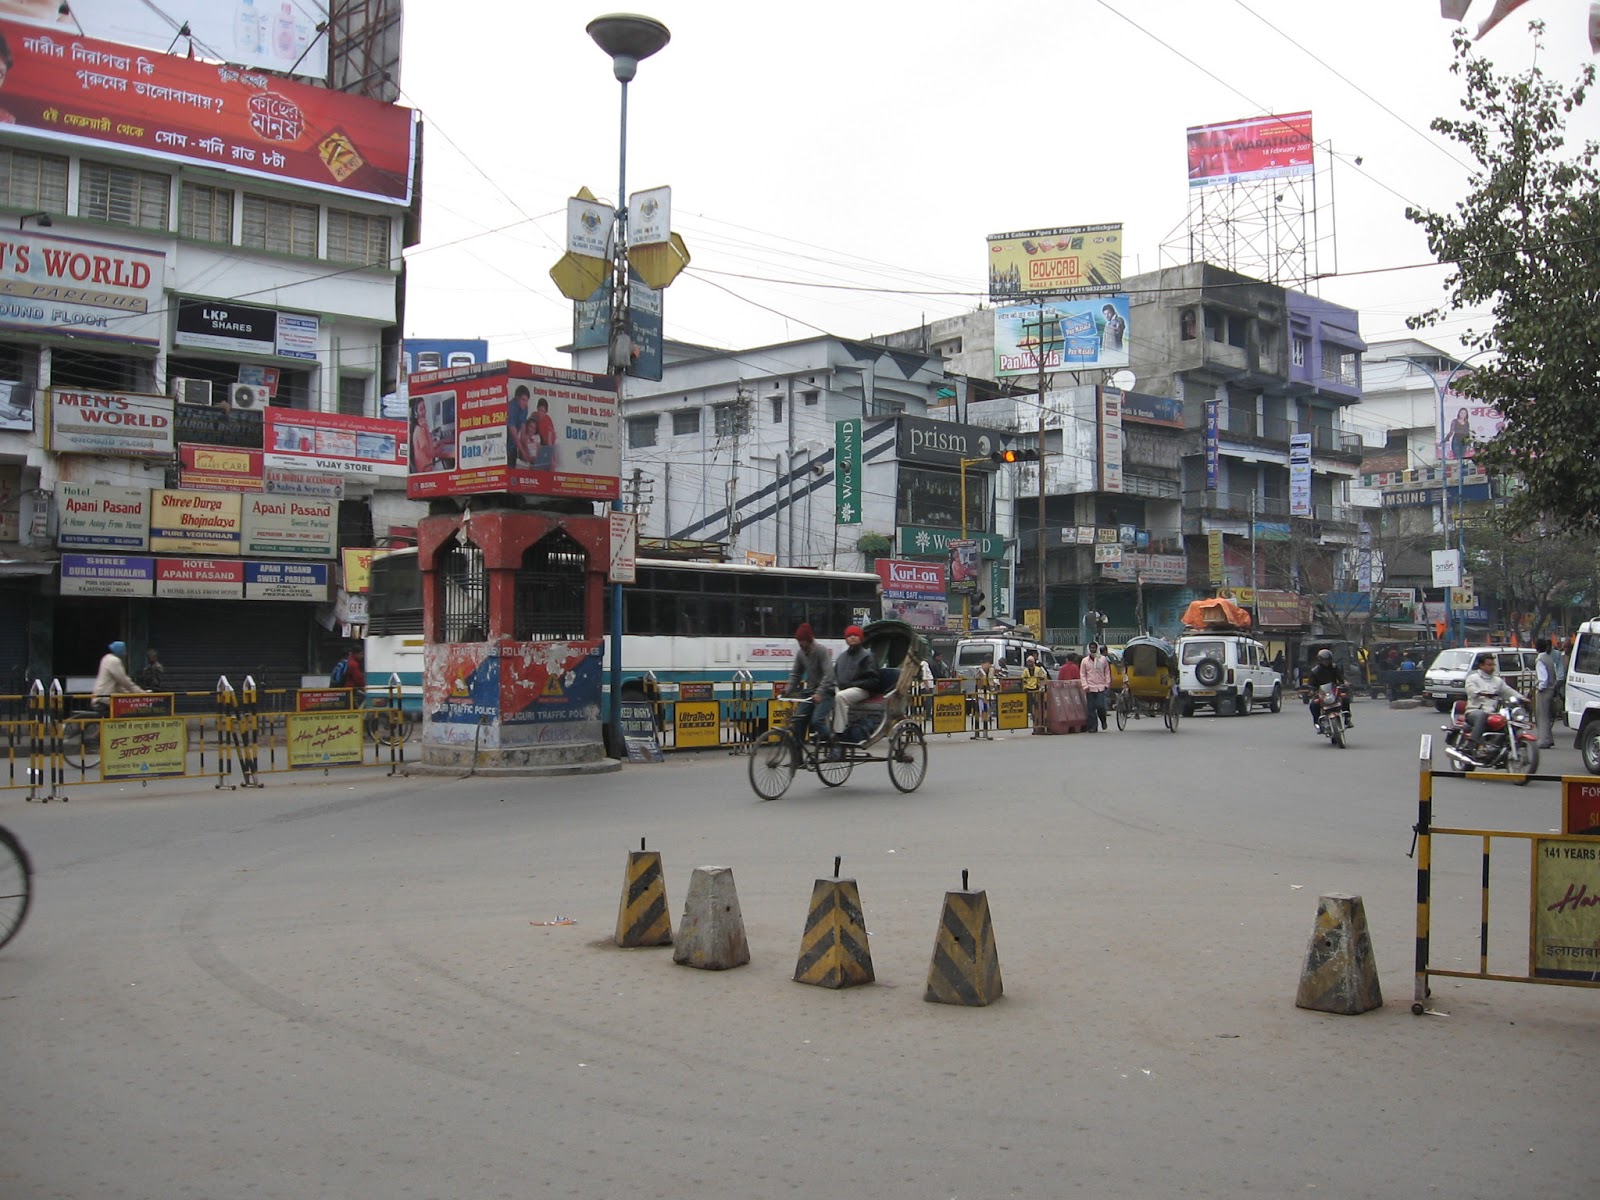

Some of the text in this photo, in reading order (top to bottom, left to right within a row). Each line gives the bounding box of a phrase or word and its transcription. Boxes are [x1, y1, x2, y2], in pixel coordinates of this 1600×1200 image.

[23, 36, 155, 75] নারীর নিরাপত্তা কি
[76, 69, 128, 91] পুরুষের
[251, 96, 299, 120] কাছের
[251, 112, 299, 140] মানুষ
[116, 124, 144, 137] থেকে
[231, 146, 256, 161] রাত
[262, 150, 286, 168] ৮টা
[1270, 146, 1296, 156] February
[1297, 144, 1310, 152] 2007
[42, 248, 151, 289] WORLD
[1033, 259, 1075, 278] POLYCAB
[32, 286, 142, 308] PARLOUR
[52, 308, 108, 328] FLOOR
[203, 308, 228, 321] LKP
[212, 320, 252, 332] SHARES
[1000, 355, 1020, 371] Pan
[58, 393, 129, 410] MEN'S
[80, 409, 168, 428] WORLD
[910, 426, 968, 455] prism
[222, 461, 248, 472] CARE
[316, 460, 374, 472] VIJAY STORE
[64, 486, 90, 496] Hotel
[162, 494, 222, 512] Shree Durga
[1382, 492, 1426, 505] MSUNG
[66, 498, 142, 514] Apani Pasand
[252, 500, 331, 517] Apani Pasand
[181, 514, 236, 528] Bhojnalaya
[86, 557, 126, 565] SHREE
[183, 560, 216, 570] HOTEL
[69, 567, 97, 576] DURGA
[162, 570, 235, 580] APANI PASAND
[260, 564, 312, 574] APANI PASAND
[890, 563, 938, 582] Kurl-on
[770, 648, 794, 658] SCHOOL
[450, 704, 496, 716] TRAFFIC POLICE
[503, 710, 566, 722] SILIGURI TRAFFIC
[679, 710, 716, 722] UltraTech
[110, 736, 130, 750] हर
[118, 741, 178, 760] आपके साथ
[1544, 847, 1596, 860] 141 YEARS
[1546, 944, 1600, 958] इलाहाबा
